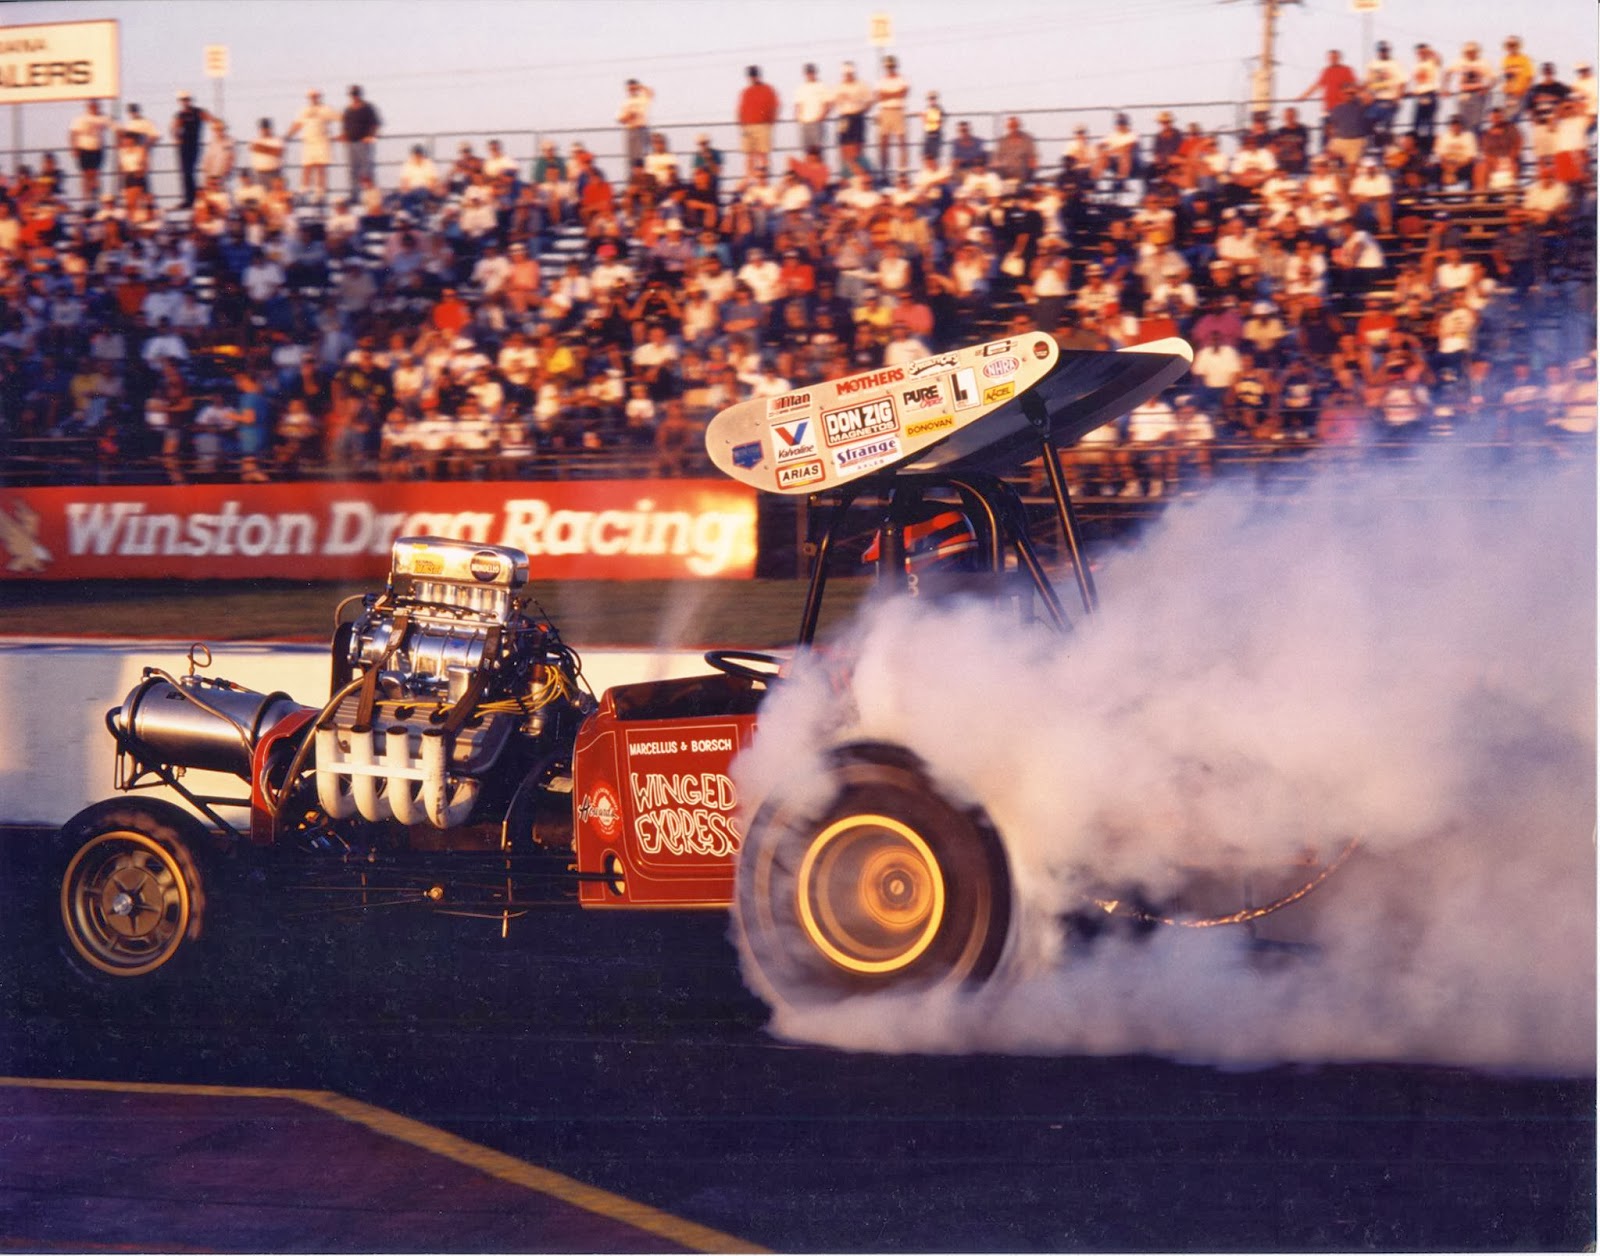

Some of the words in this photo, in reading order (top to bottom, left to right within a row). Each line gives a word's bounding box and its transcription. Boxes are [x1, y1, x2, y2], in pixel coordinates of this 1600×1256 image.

[836, 368, 904, 395] MOTHERS
[903, 385, 939, 405] PURE
[826, 408, 862, 435] DON
[862, 401, 893, 427] ZIG
[907, 418, 952, 435] DONOVAN
[830, 421, 894, 443] MAGNETOS
[778, 445, 814, 459] Valvoline
[837, 440, 896, 464] Strange
[782, 465, 819, 481] ARIAS
[65, 502, 315, 556] Winston
[502, 499, 755, 575] Racing
[629, 741, 678, 756] MARCELLUS
[680, 742, 688, 751] &
[691, 739, 732, 752] BORSCH
[631, 773, 738, 812] WINGED
